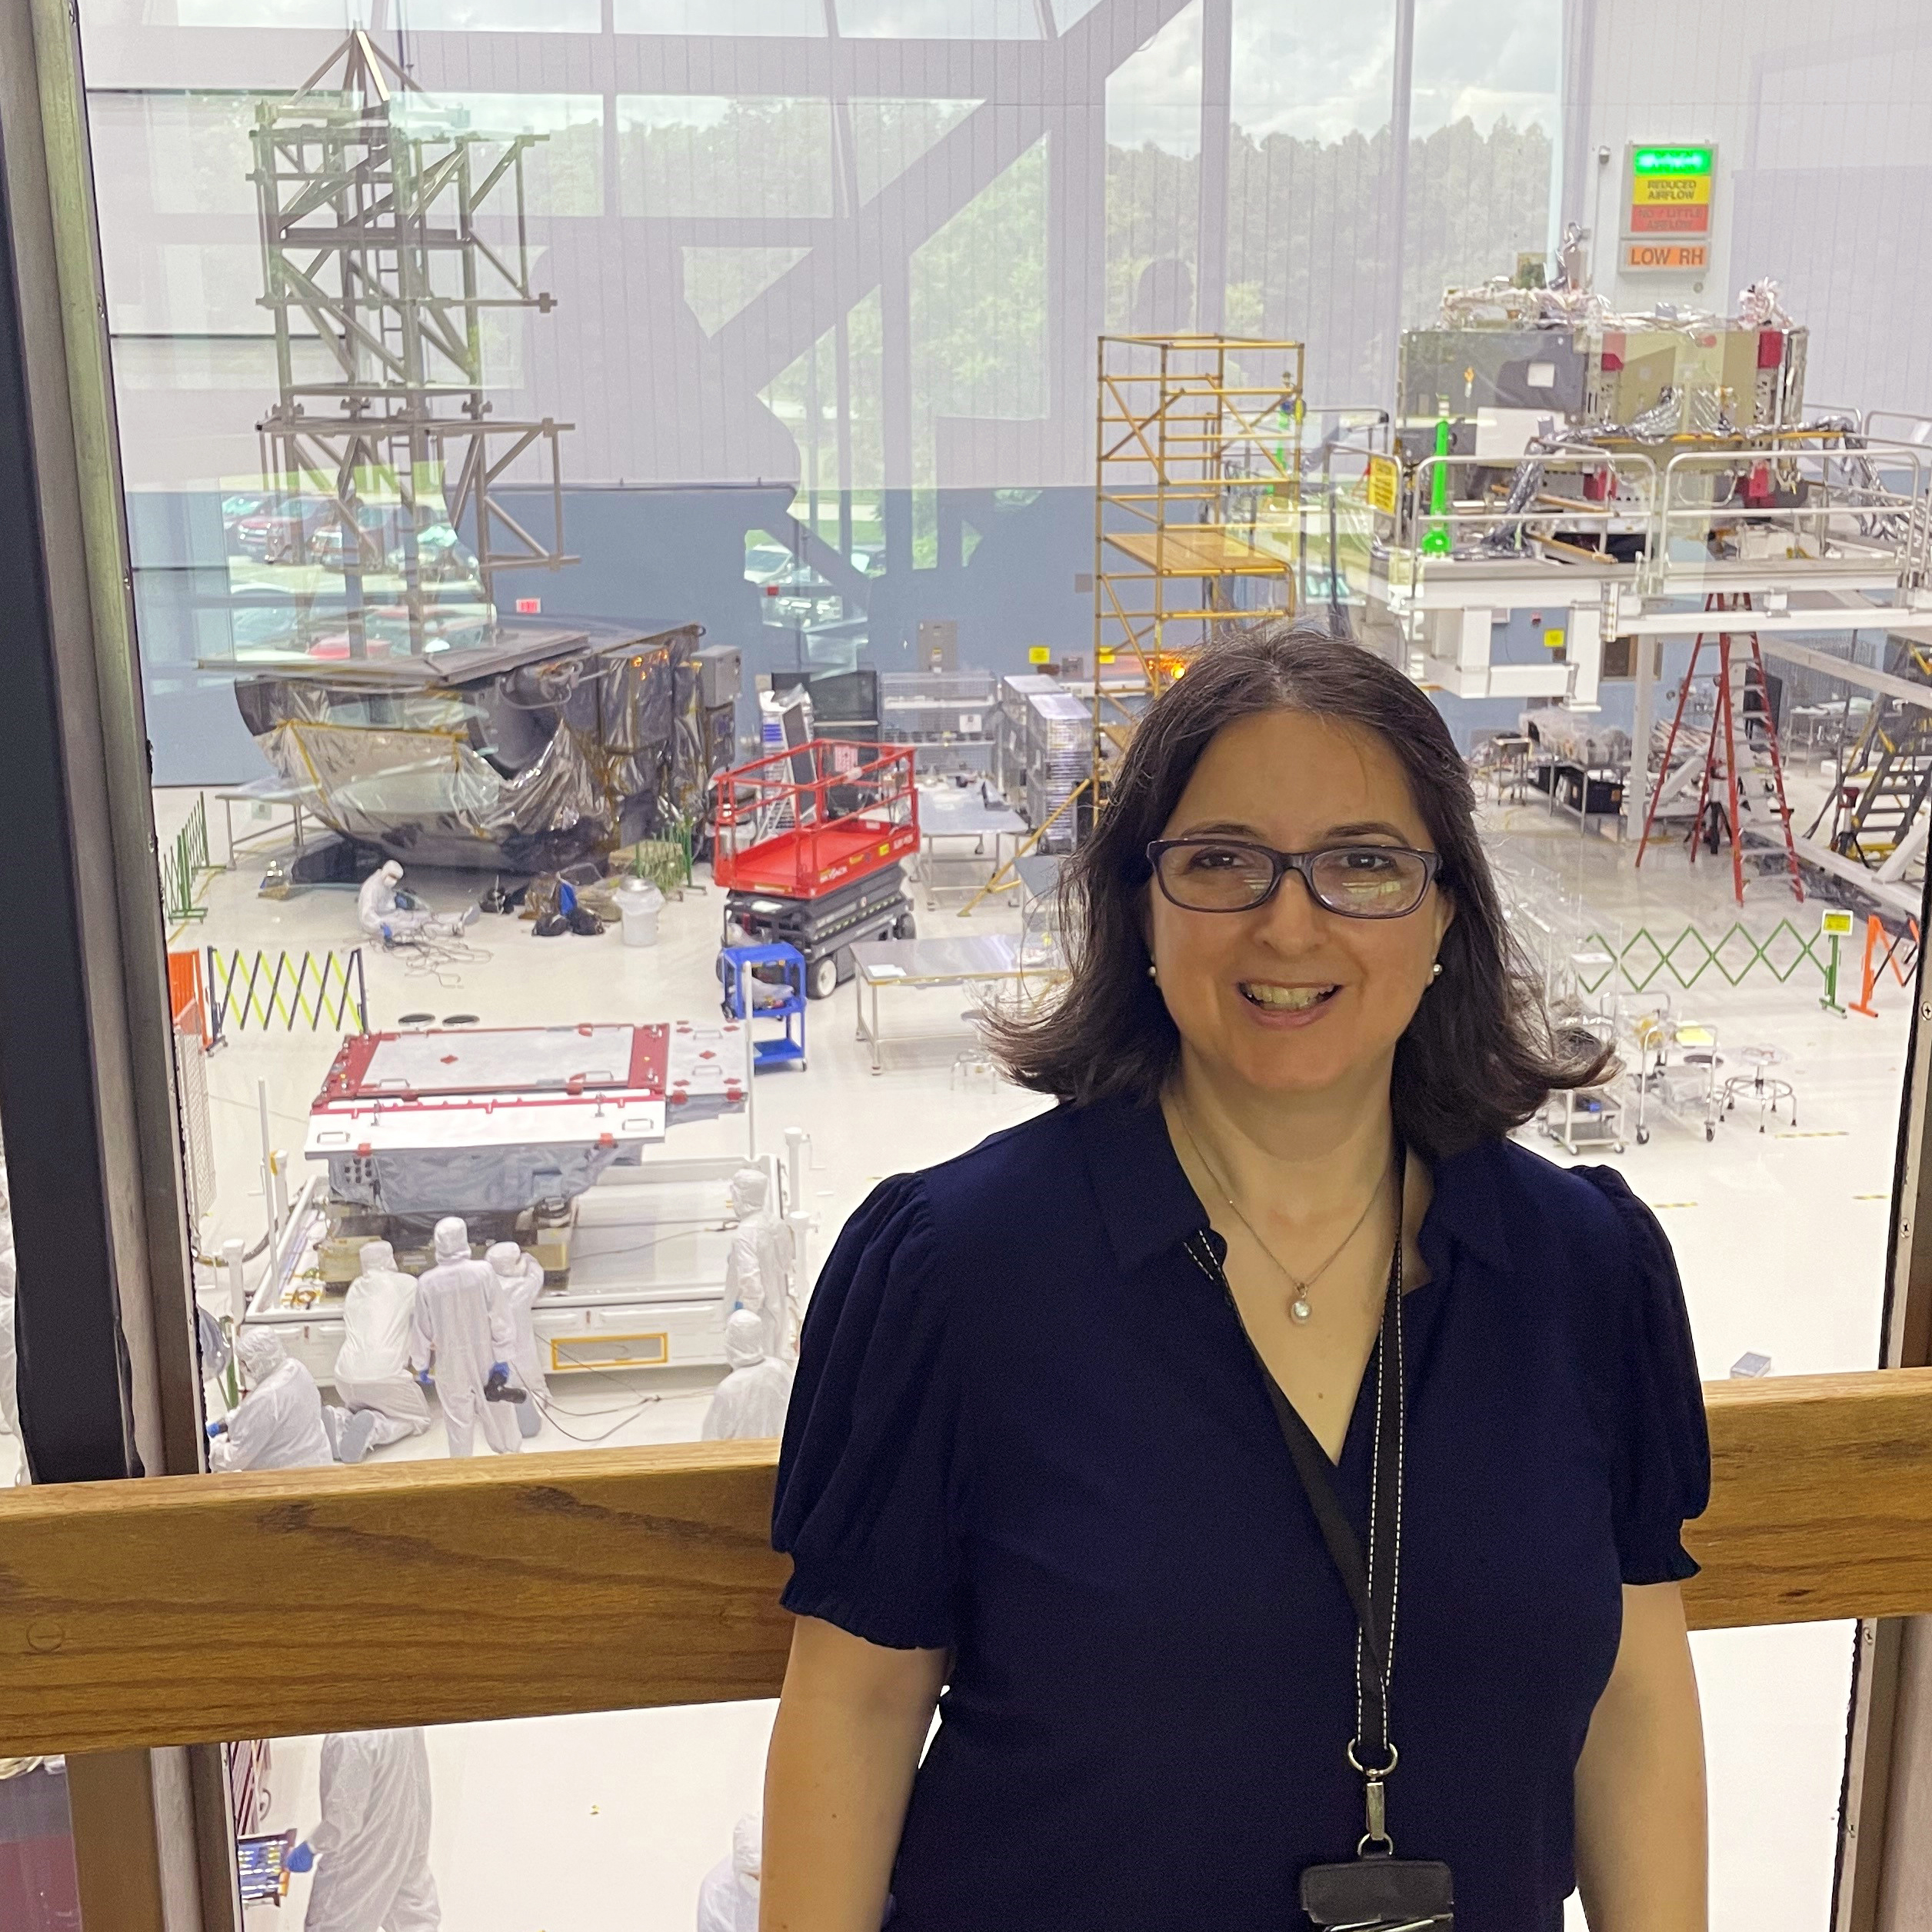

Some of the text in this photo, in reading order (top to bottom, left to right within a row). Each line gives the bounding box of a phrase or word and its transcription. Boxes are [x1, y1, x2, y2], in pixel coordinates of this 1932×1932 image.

[1647, 180, 1697, 189] REDUCED
[1647, 190, 1695, 200] AIRFLOW
[1631, 247, 1704, 265] LOW RH
